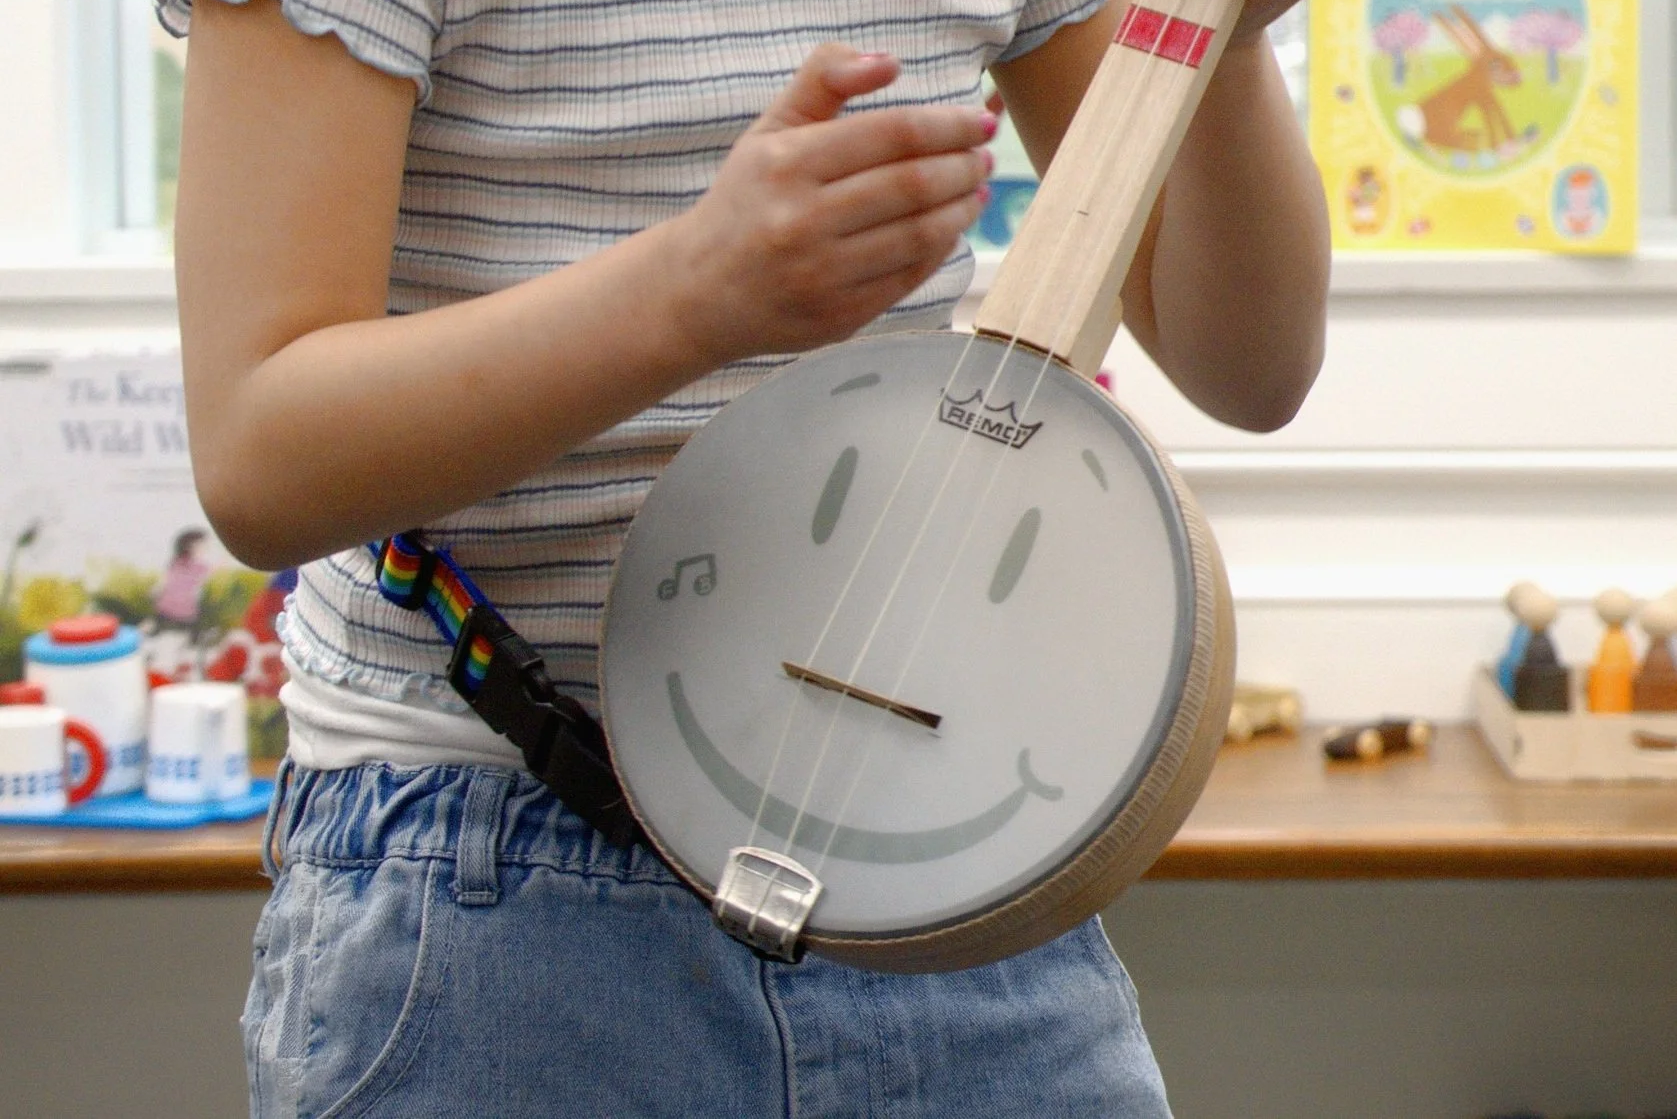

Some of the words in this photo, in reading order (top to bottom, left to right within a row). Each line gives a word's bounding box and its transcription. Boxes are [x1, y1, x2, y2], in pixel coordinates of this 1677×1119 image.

[67, 378, 110, 405] The
[60, 419, 144, 457] Wild
[947, 406, 1022, 442] REMO
